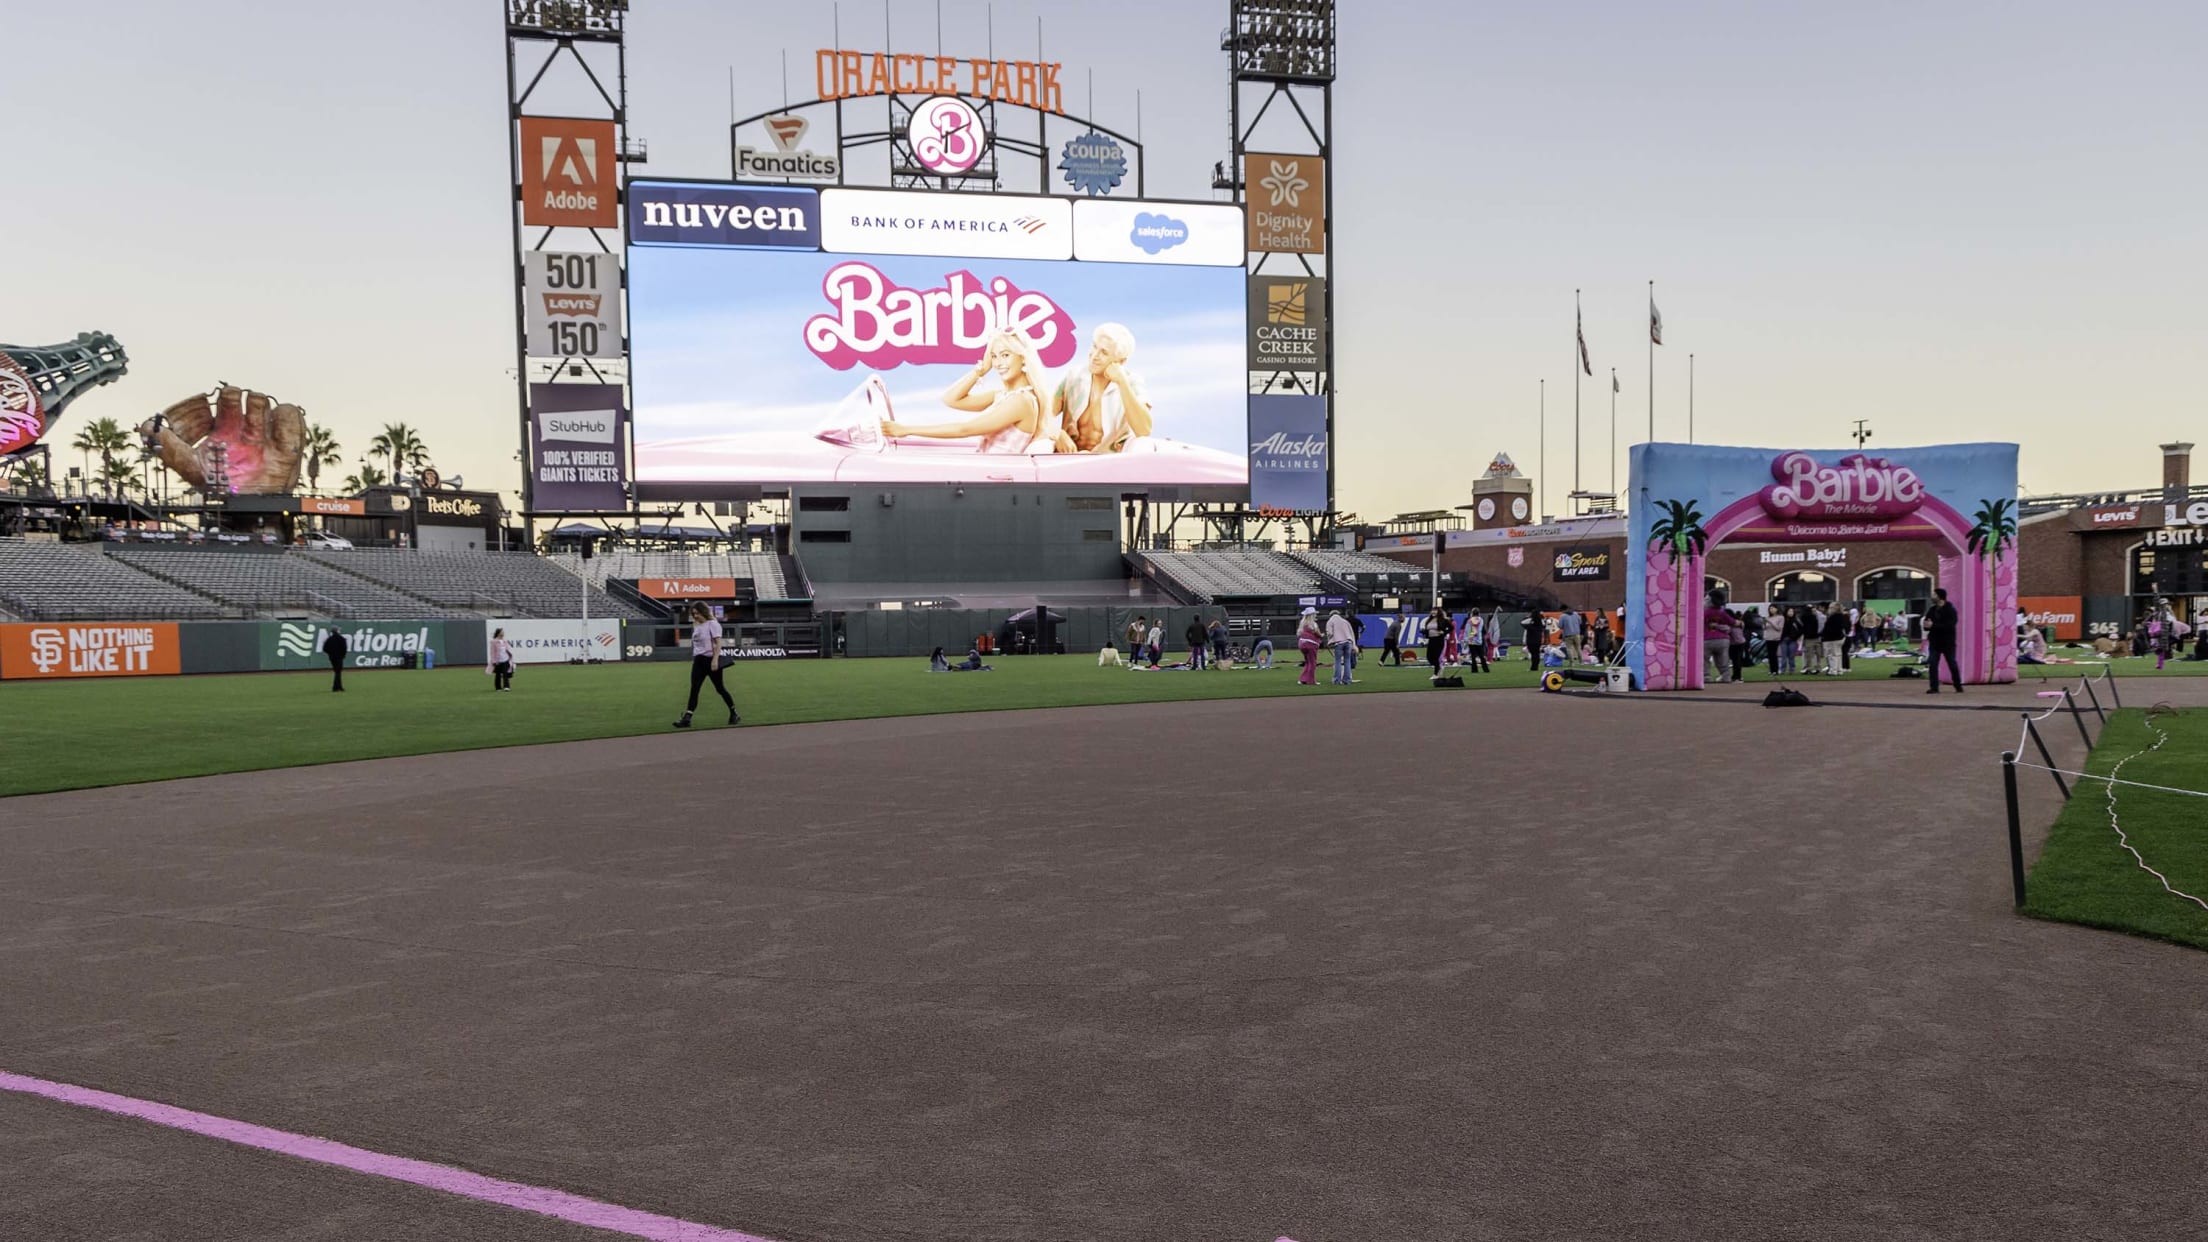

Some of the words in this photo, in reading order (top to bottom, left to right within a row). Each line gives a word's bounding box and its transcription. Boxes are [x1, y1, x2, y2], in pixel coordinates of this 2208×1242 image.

[816, 48, 957, 101] ORACLE
[970, 58, 1064, 115] PARK
[1069, 144, 1121, 164] coupa
[739, 150, 835, 176] Fanatics
[544, 190, 597, 210] Adobe
[643, 200, 806, 231] nuveen
[851, 215, 898, 228] BANK
[904, 217, 925, 229] OF
[930, 218, 1008, 232] AMERICA
[1256, 211, 1313, 233] Dignity
[1137, 225, 1184, 239] salesforce
[1260, 232, 1311, 249] Health
[546, 254, 597, 289] 501
[806, 263, 1060, 354] Barbie
[1256, 326, 1317, 341] CACHE
[1258, 340, 1314, 355] CREEK
[1256, 356, 1286, 364] CASINO
[1288, 357, 1318, 365] RESORT
[549, 419, 606, 433] StubHub
[1251, 431, 1326, 458] Alaska
[542, 450, 571, 466] 100%
[571, 450, 615, 466] VERIFIED
[1255, 460, 1319, 469] AIRLINES
[540, 466, 577, 482] GIANTS
[578, 467, 619, 482] TICKETS
[1771, 453, 1921, 508] Barbie
[316, 500, 351, 512] cruise
[452, 498, 481, 516] Coffee
[1295, 508, 1324, 517] LIGHT
[1824, 504, 1843, 514] The
[1843, 504, 1877, 514] Movie
[2156, 529, 2194, 546] EXIT
[1571, 552, 1608, 568] Sports
[1760, 551, 1805, 563] Humm
[1807, 548, 1847, 562] Baby!
[1562, 568, 1578, 576] BAY
[1578, 567, 1599, 575] AREA
[682, 584, 711, 593] Adobe
[2088, 622, 2119, 634] 365
[68, 628, 154, 650] NOTHING
[526, 639, 540, 649] OF
[543, 638, 592, 649] AMERICA
[69, 648, 119, 672] LIKE
[125, 644, 154, 671] IT
[626, 645, 653, 657] 399
[747, 648, 786, 657] MINOLTA
[355, 655, 379, 666] Car
[381, 655, 405, 666] Ren
